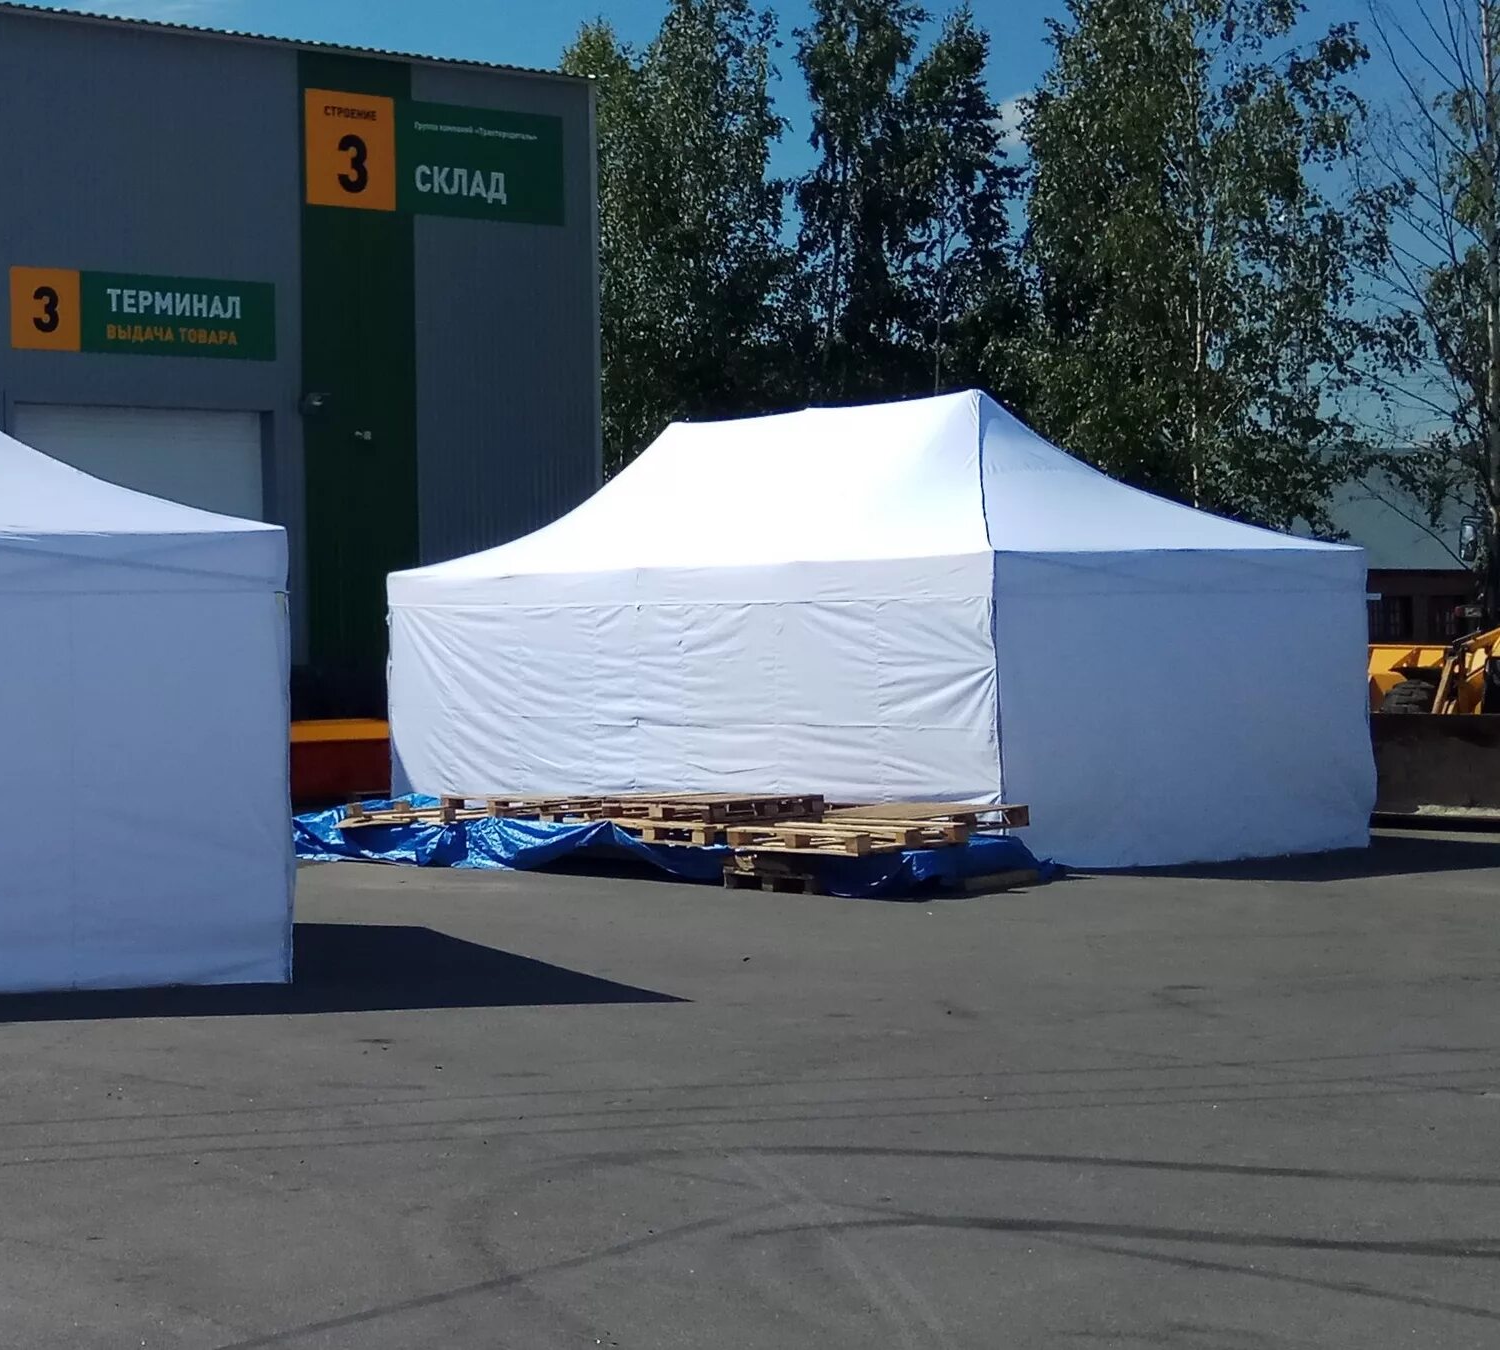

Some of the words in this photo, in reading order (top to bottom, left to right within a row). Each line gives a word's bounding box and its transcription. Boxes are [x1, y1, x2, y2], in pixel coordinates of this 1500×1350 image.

[324, 105, 377, 121] СТРОЕНИЕ
[337, 134, 368, 193] 3
[414, 164, 507, 205] СКЛАД
[32, 286, 59, 333] 3
[107, 288, 241, 319] ТЕРМИНАЛ
[106, 324, 174, 343] ВЫДАЧА
[180, 327, 238, 345] ТОВАРА
